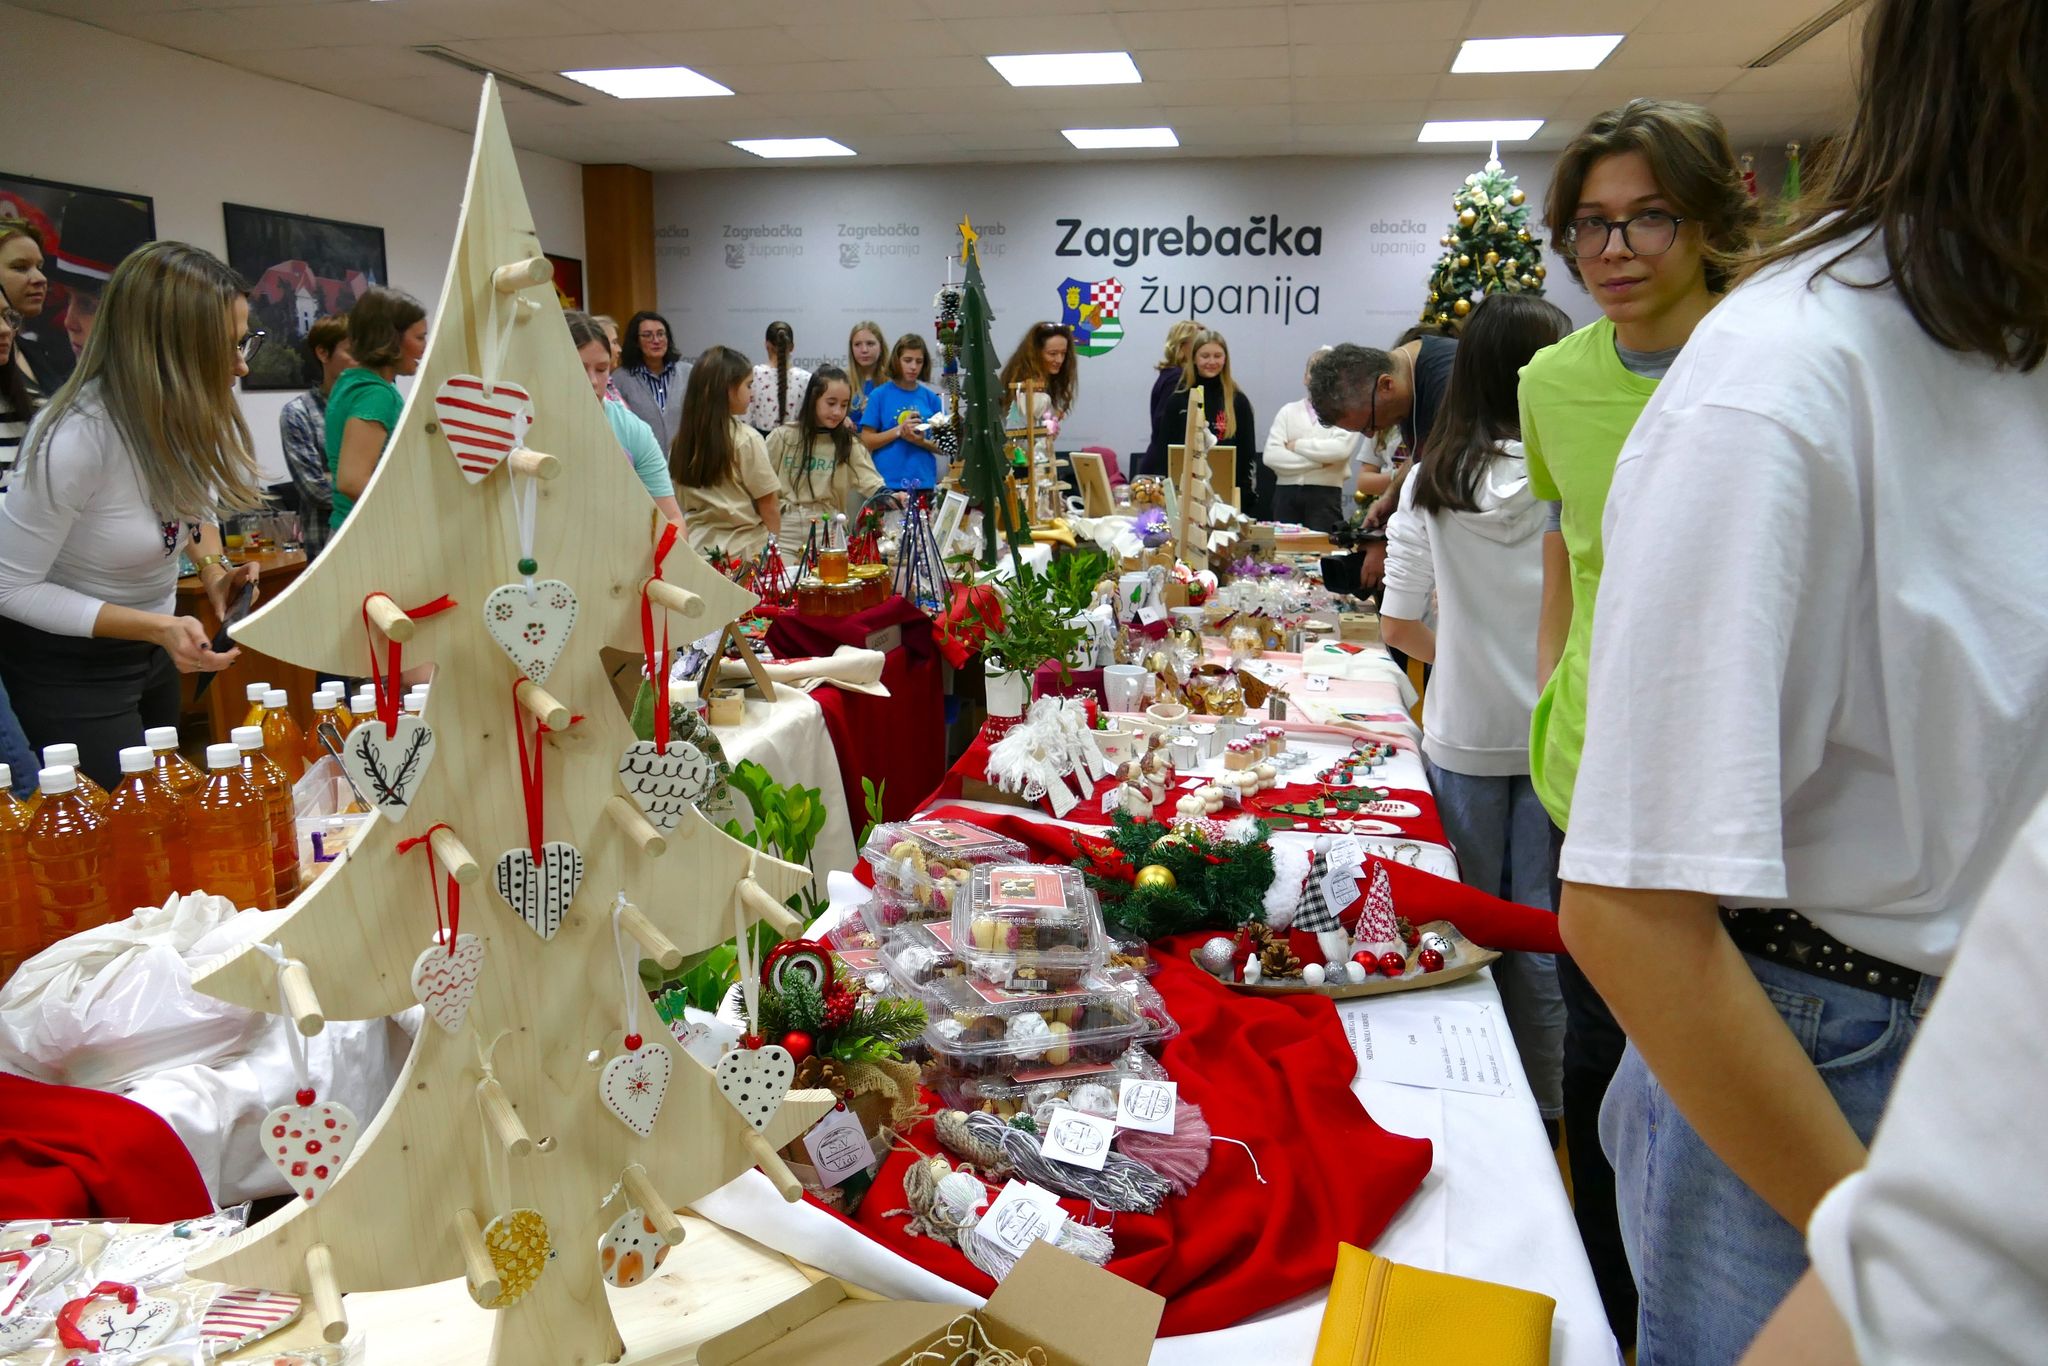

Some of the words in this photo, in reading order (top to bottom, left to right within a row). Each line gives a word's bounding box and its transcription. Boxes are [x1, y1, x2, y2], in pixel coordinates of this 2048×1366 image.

[723, 224, 803, 240] Zagrebačka
[838, 223, 920, 239] Zagrebačka
[1370, 219, 1427, 234] ebačka
[1055, 214, 1322, 267] Zagrebačka
[1370, 240, 1426, 256] upanija
[749, 243, 803, 259] županija
[864, 242, 920, 257] županija
[1139, 276, 1320, 325] županija
[834, 1154, 858, 1168] Vida
